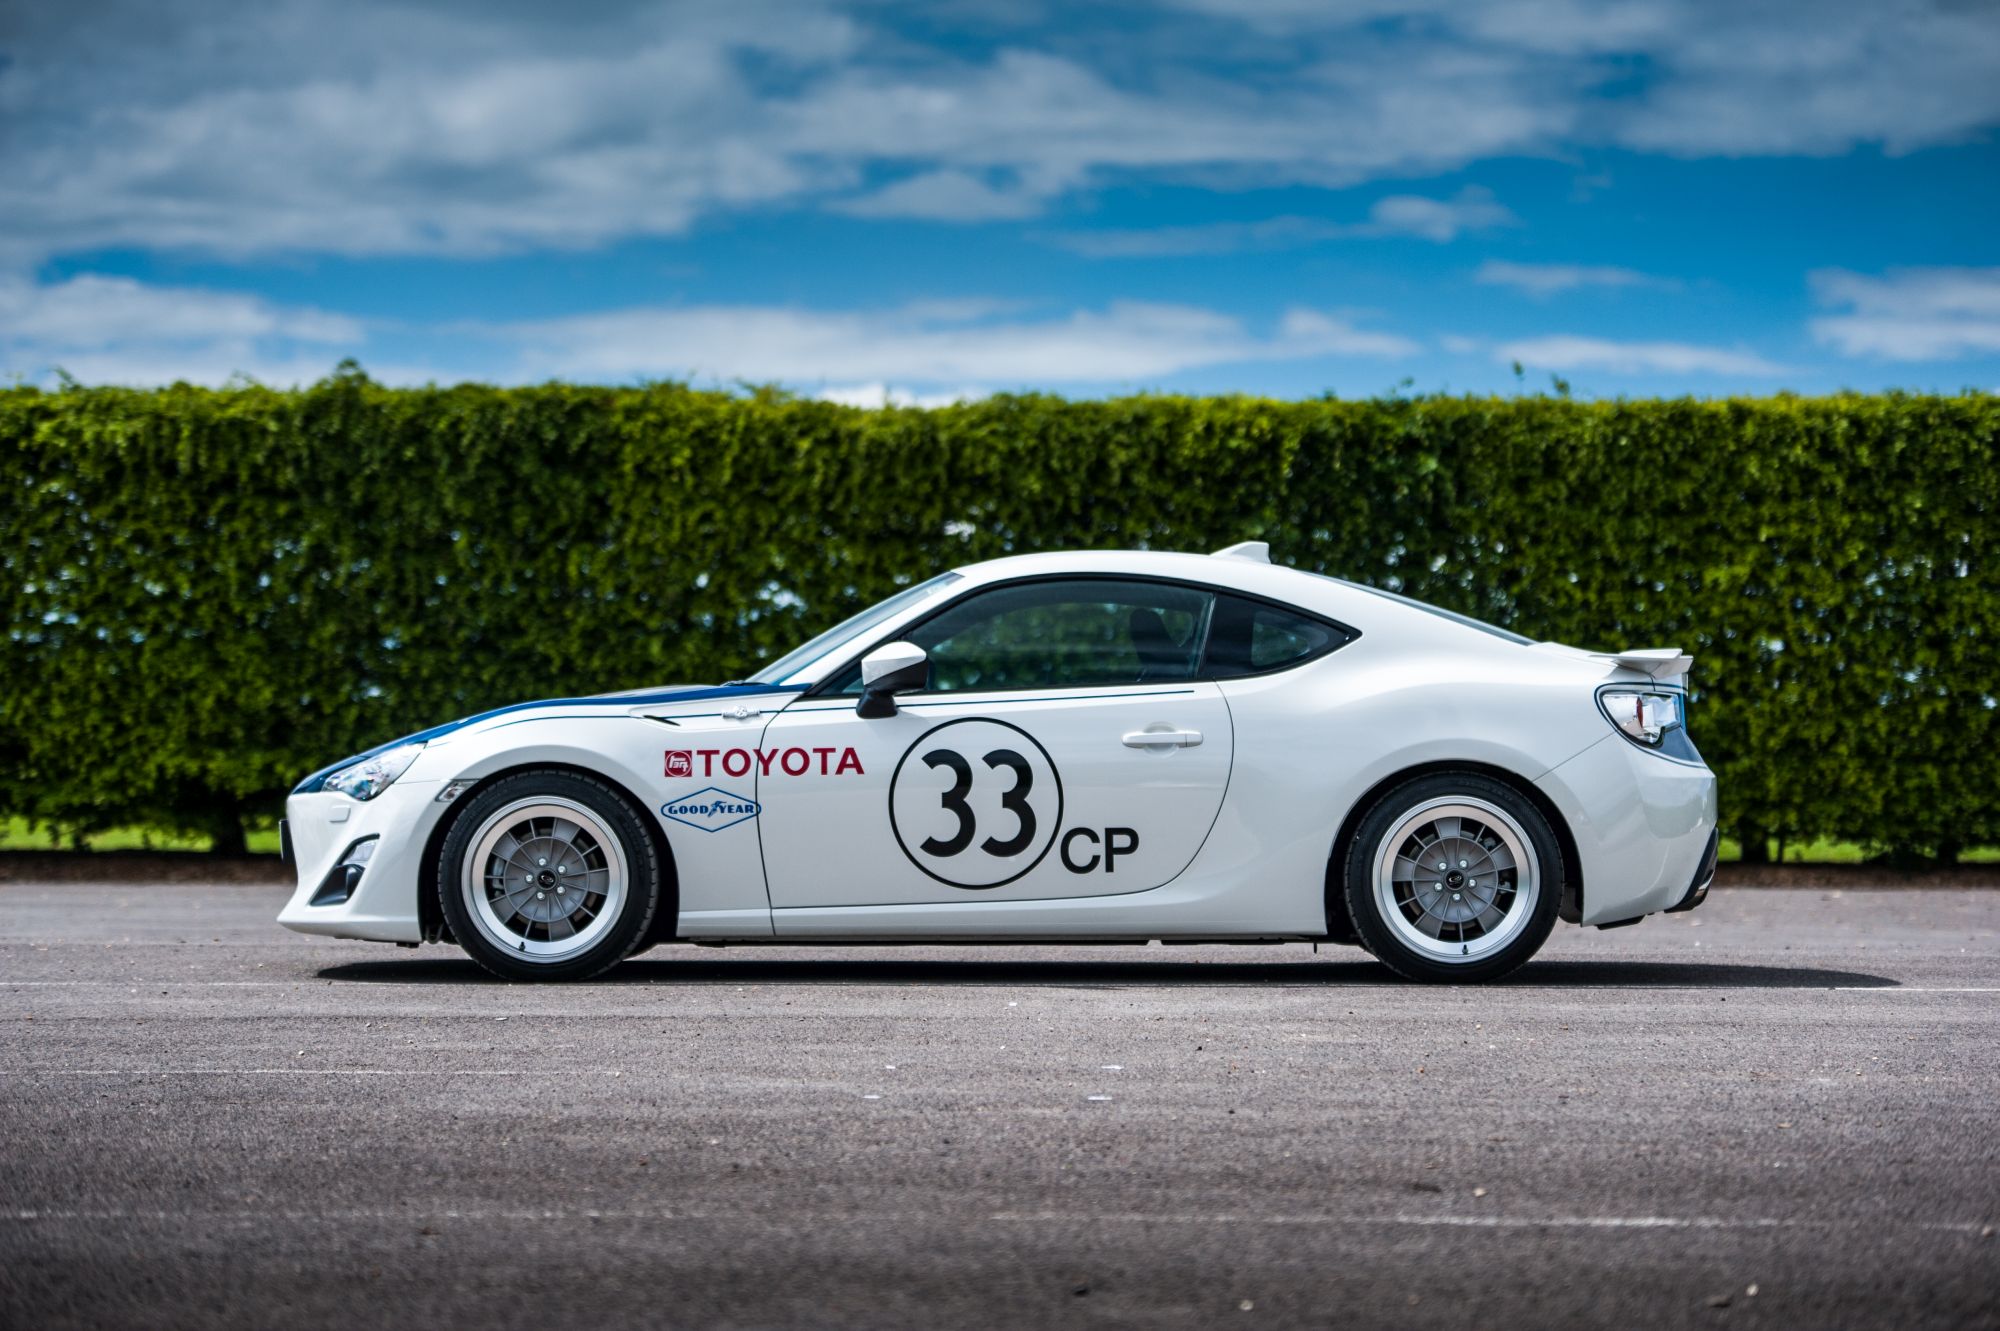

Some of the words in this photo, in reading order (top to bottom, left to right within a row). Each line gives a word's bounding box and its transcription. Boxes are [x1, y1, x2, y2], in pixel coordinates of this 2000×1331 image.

[697, 747, 864, 777] TOYOTA
[920, 749, 1036, 857] 33
[1060, 827, 1140, 874] CP
